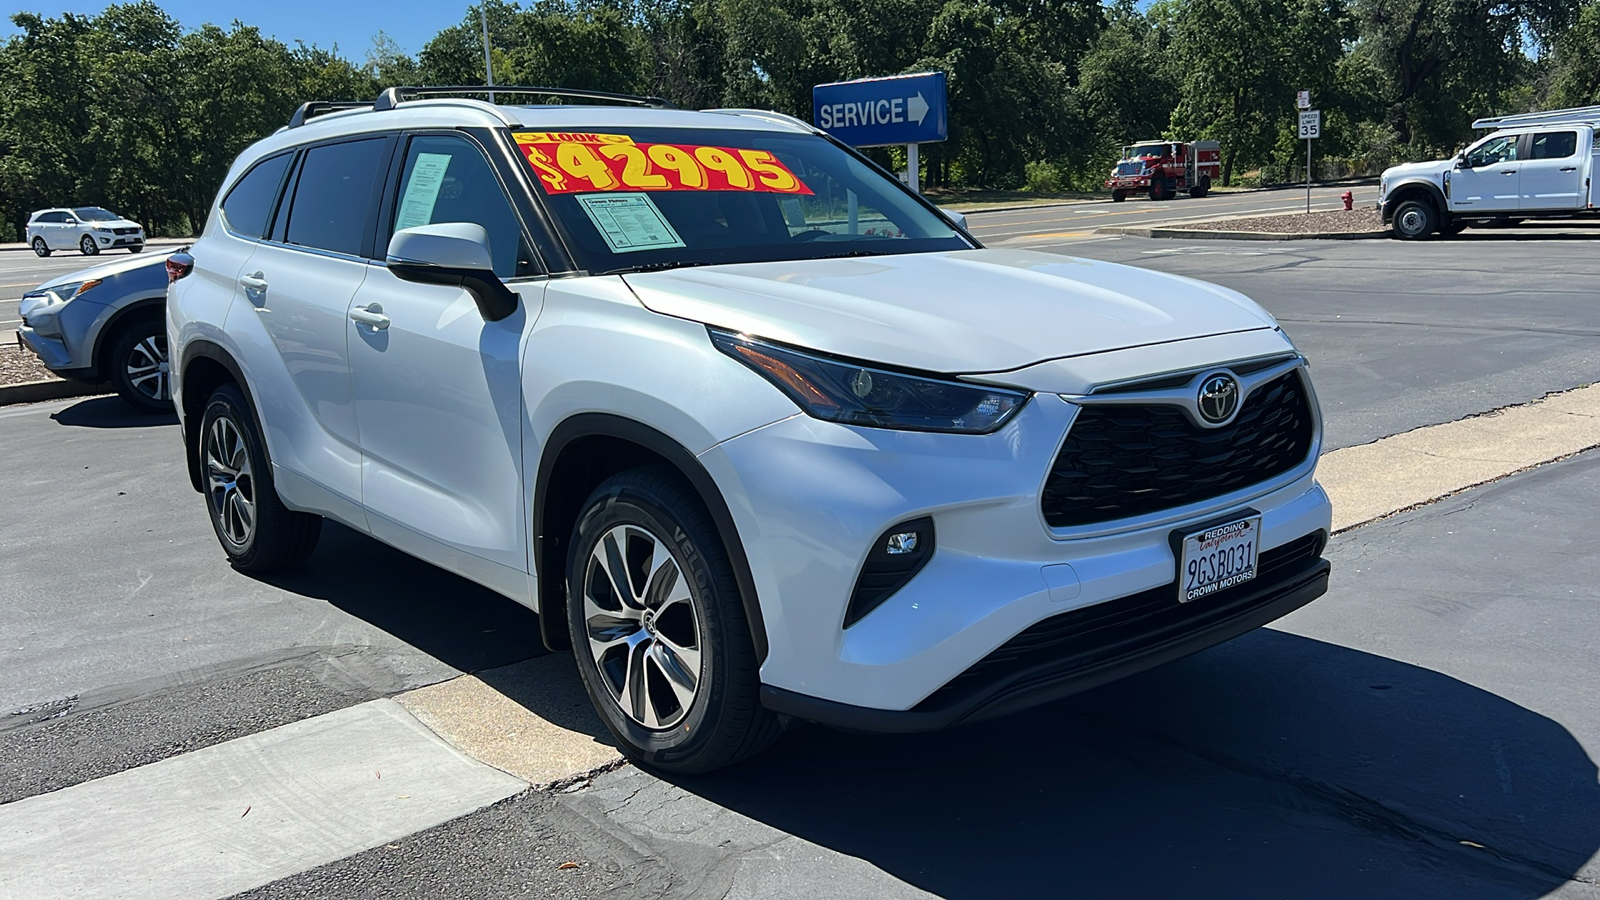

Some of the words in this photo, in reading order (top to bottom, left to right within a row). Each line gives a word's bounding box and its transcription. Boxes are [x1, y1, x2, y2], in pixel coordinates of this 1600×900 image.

[820, 98, 904, 129] SERVICE
[546, 132, 603, 143] LOOK
[1301, 125, 1318, 136] 35
[528, 141, 800, 190] $42995
[1205, 521, 1245, 540] REDDING
[1186, 540, 1253, 591] 9GSB031
[672, 525, 721, 652] VELOCITY
[1187, 583, 1219, 600] CROWN
[1219, 570, 1253, 589] MOTORS
